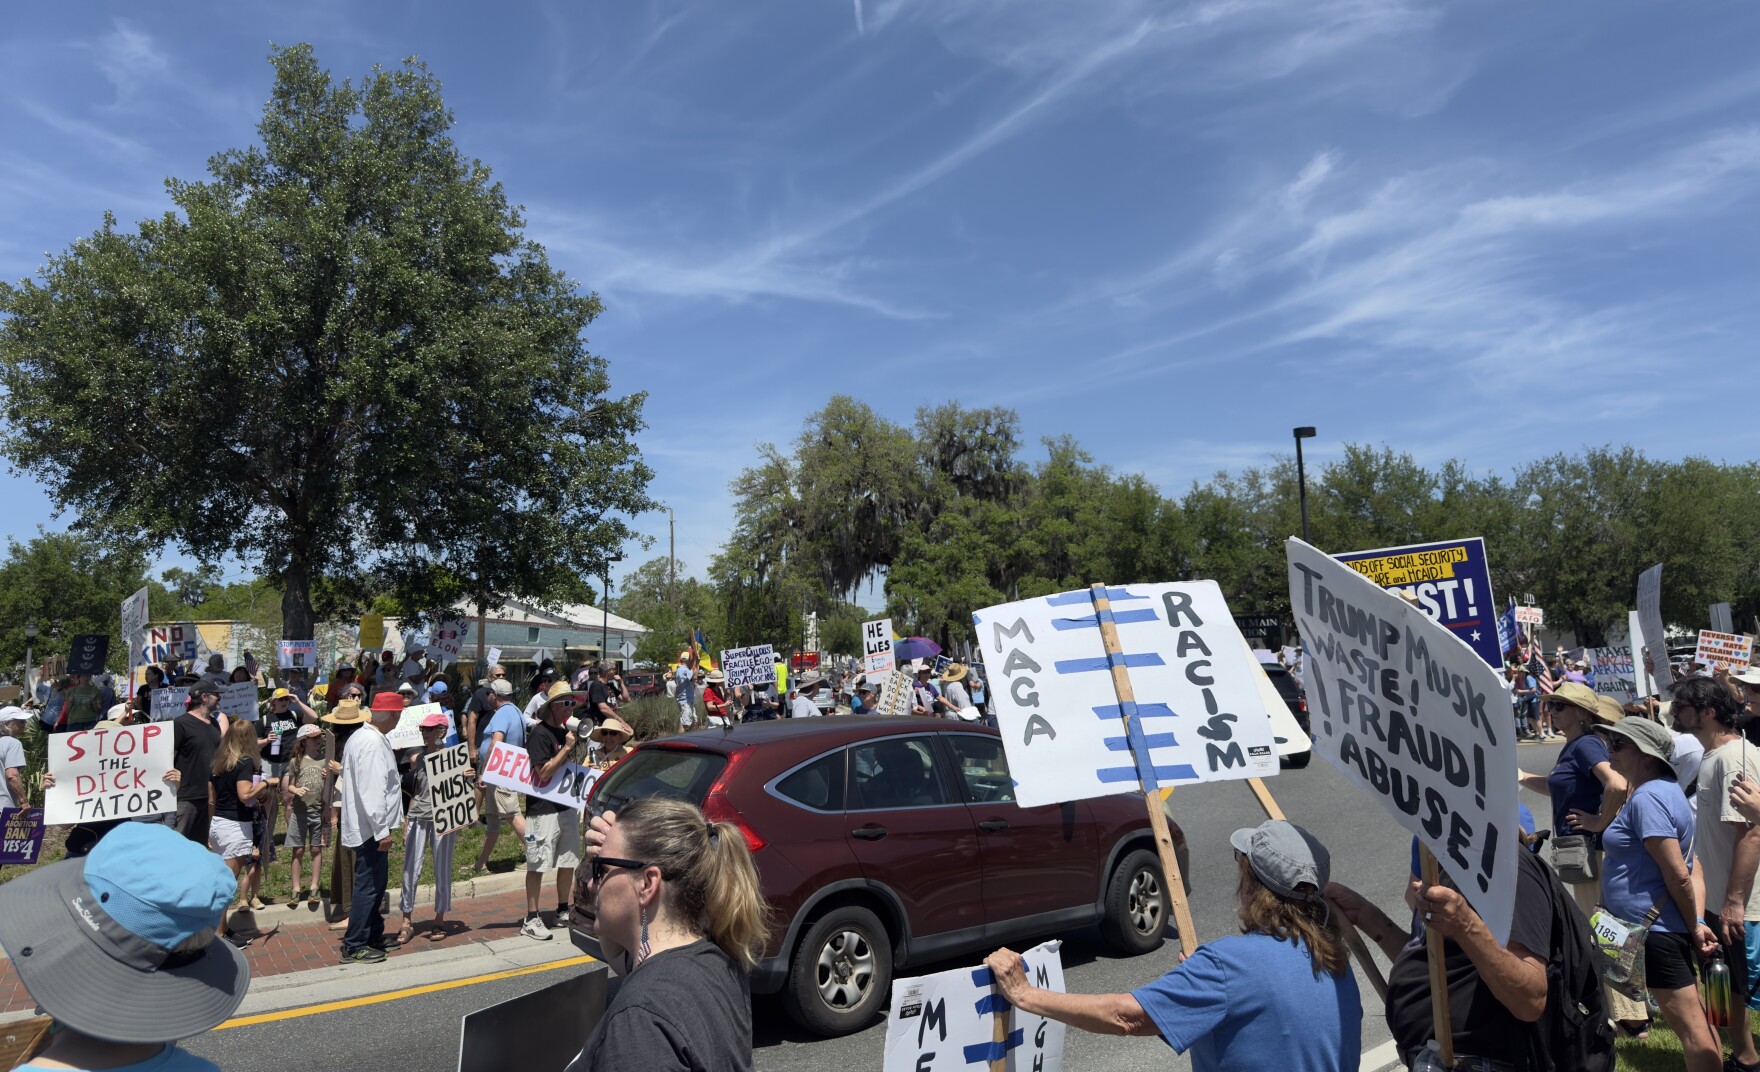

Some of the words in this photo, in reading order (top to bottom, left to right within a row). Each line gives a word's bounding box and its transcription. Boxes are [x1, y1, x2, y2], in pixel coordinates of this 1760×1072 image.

[1346, 560, 1369, 574] NDS
[1368, 559, 1385, 573] OFF
[1386, 554, 1417, 570] SOCIAL
[1419, 548, 1464, 565] SECURITY
[1392, 575, 1406, 584] and
[151, 626, 184, 645] NO
[867, 622, 884, 638] HE
[1701, 631, 1736, 641] REVERSE
[142, 641, 197, 664] KINGS
[431, 638, 459, 655] ELON
[866, 640, 890, 655] LIES
[1293, 562, 1401, 661] TRUMP
[1405, 624, 1497, 747] MUSK
[1594, 646, 1632, 657] MAKE
[1699, 646, 1733, 655] RECLAIM
[1300, 617, 1420, 716] WASTE!
[1596, 655, 1633, 666] NAZIS
[1706, 654, 1748, 666] HUMANITY
[727, 668, 750, 678] TRUMP
[1593, 664, 1634, 675] AFRAID
[727, 677, 741, 688] SO
[889, 677, 908, 691] BACK
[993, 617, 1057, 746] MAGA
[1162, 591, 1247, 772] RACISM
[1597, 681, 1627, 692] AGAIN
[66, 725, 162, 763] STOP
[1337, 678, 1486, 811] FRAUD!
[98, 756, 131, 771] THE
[427, 744, 468, 776] THIS
[76, 767, 147, 796] DICK
[431, 773, 475, 808] MUSK
[557, 767, 597, 802] DOG
[74, 789, 163, 820] TATOR
[1340, 732, 1498, 893] ABUSE!
[5, 820, 38, 828] ABORTION
[434, 796, 477, 834] STOP
[4, 827, 31, 840] BAN!
[3, 839, 21, 853] YES
[20, 839, 35, 860] 4
